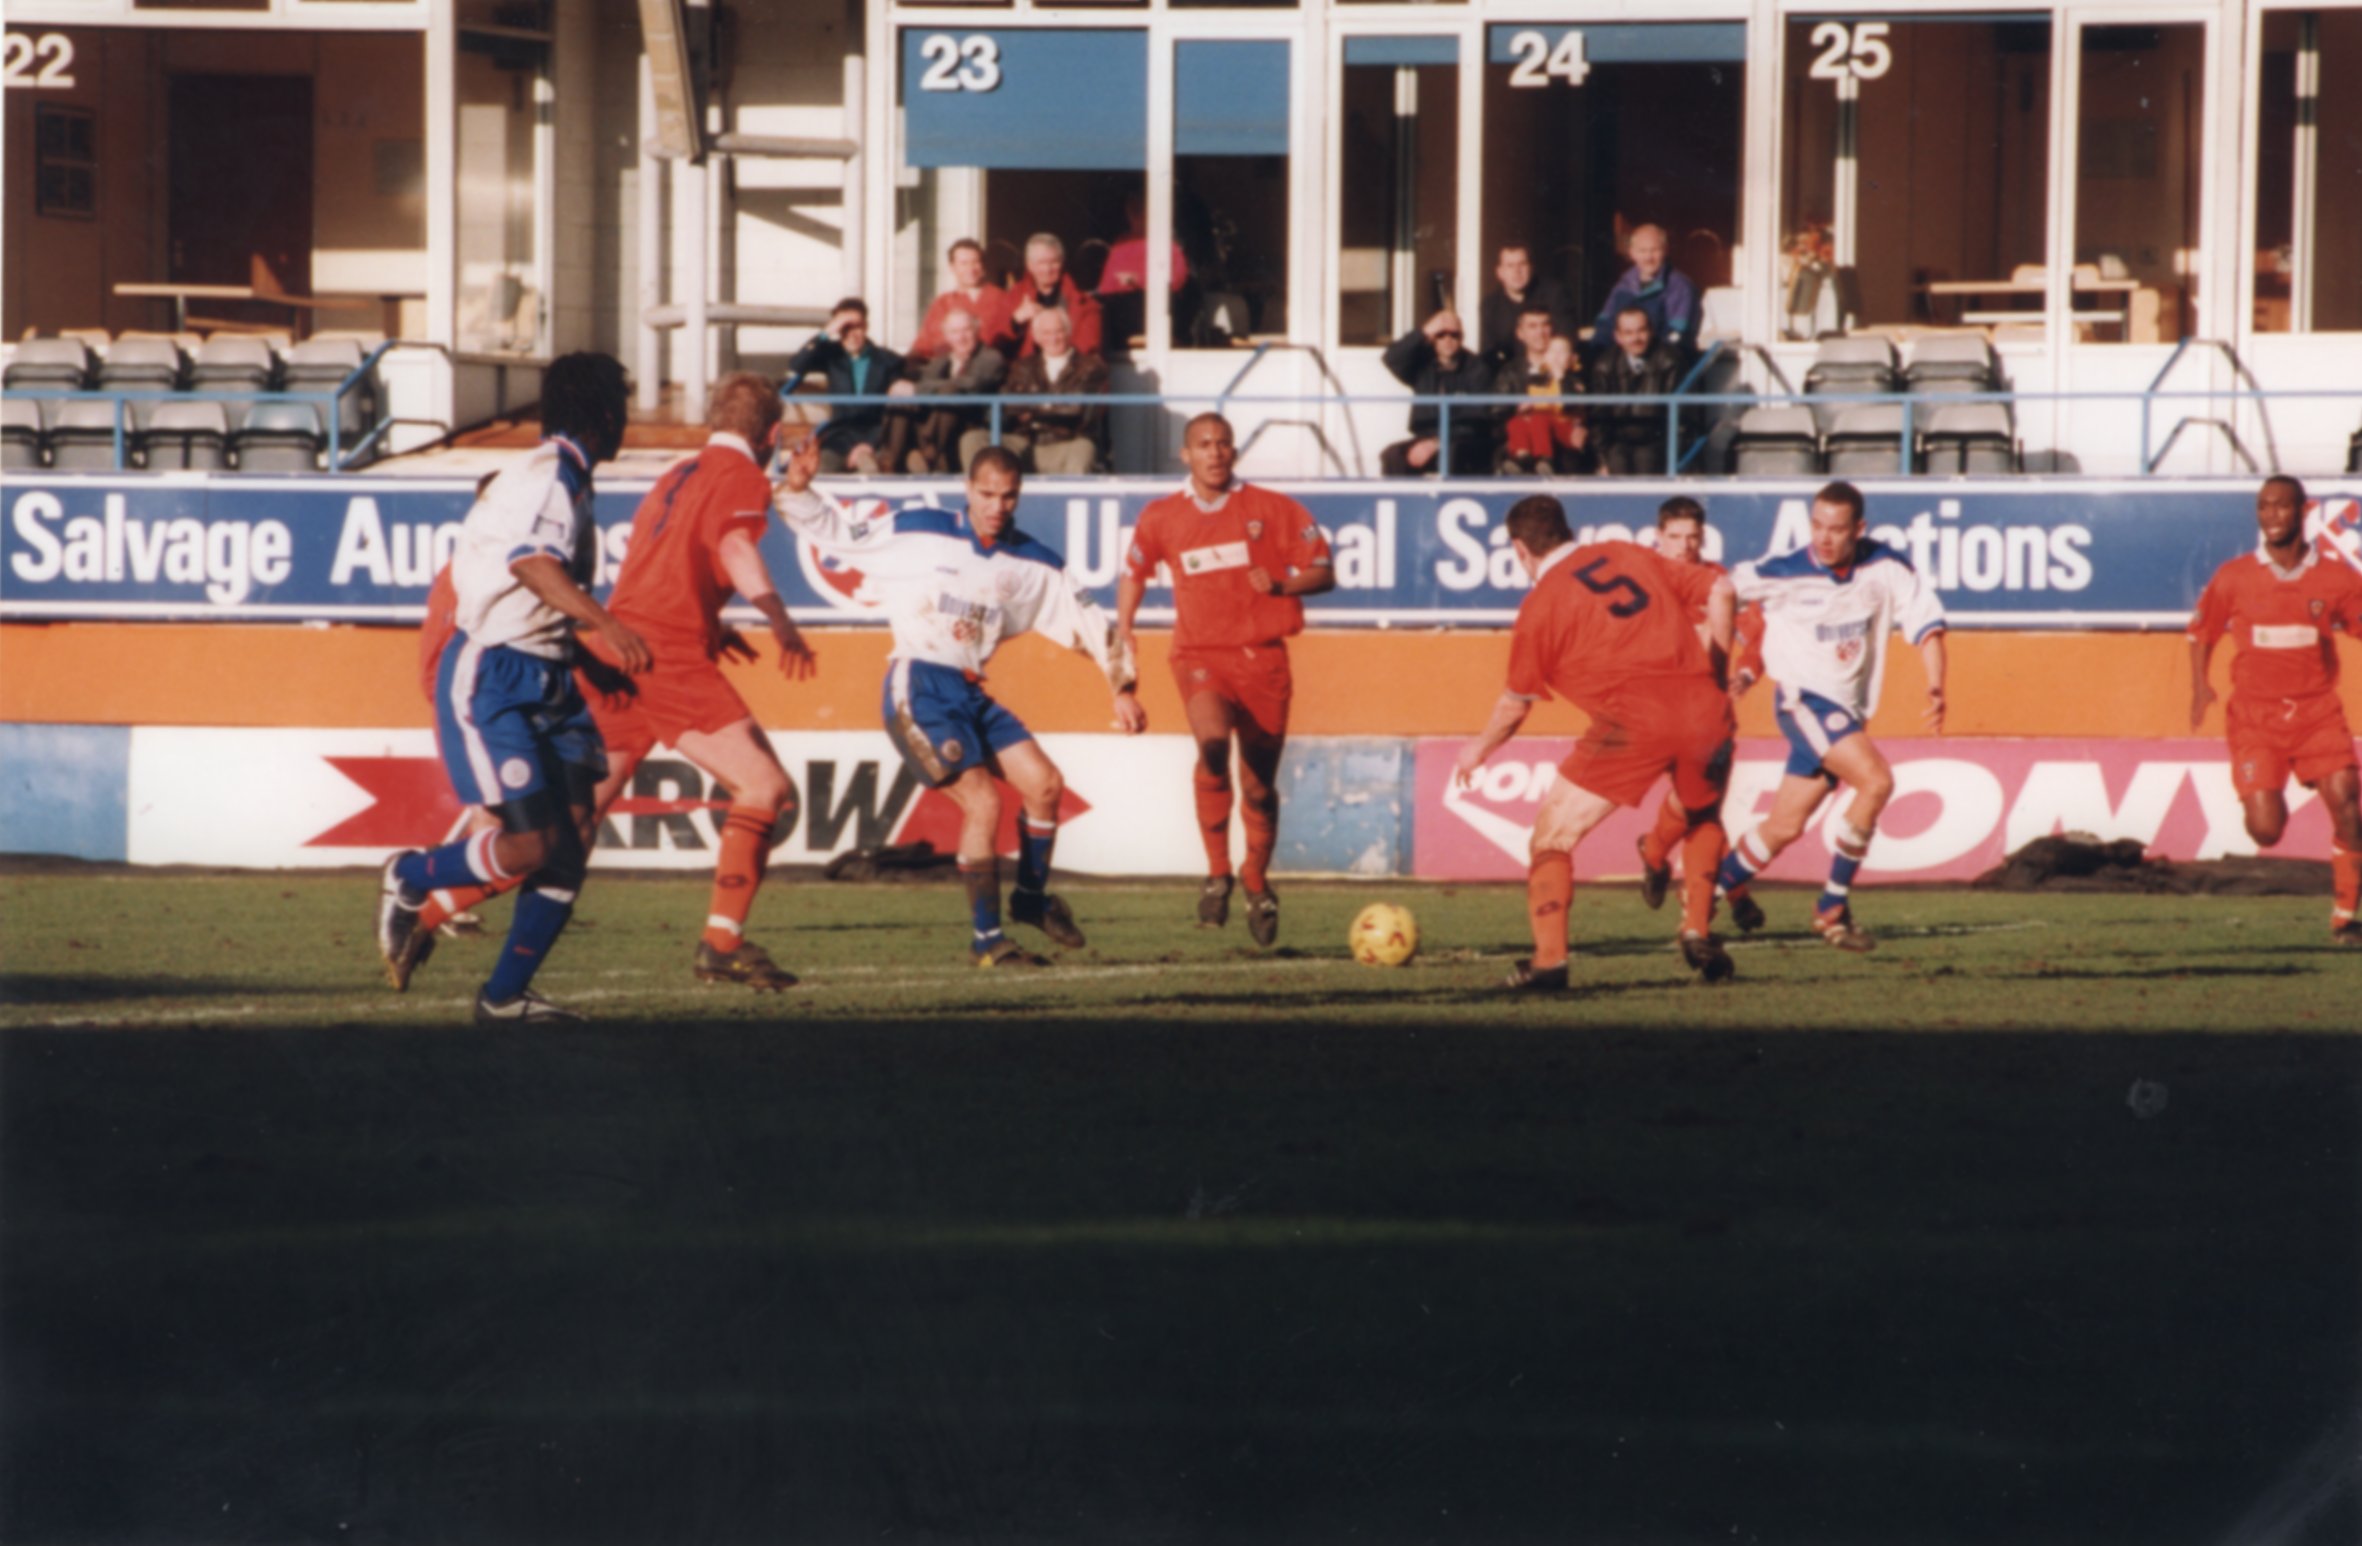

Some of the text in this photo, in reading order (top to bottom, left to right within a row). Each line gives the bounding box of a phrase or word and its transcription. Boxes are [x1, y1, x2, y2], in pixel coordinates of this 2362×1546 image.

[3, 32, 74, 88] 22
[920, 33, 1003, 91] 23
[1509, 30, 1590, 87] 24
[1809, 21, 1892, 79] 25
[11, 492, 293, 605] Salvage
[1573, 556, 1650, 619] 5
